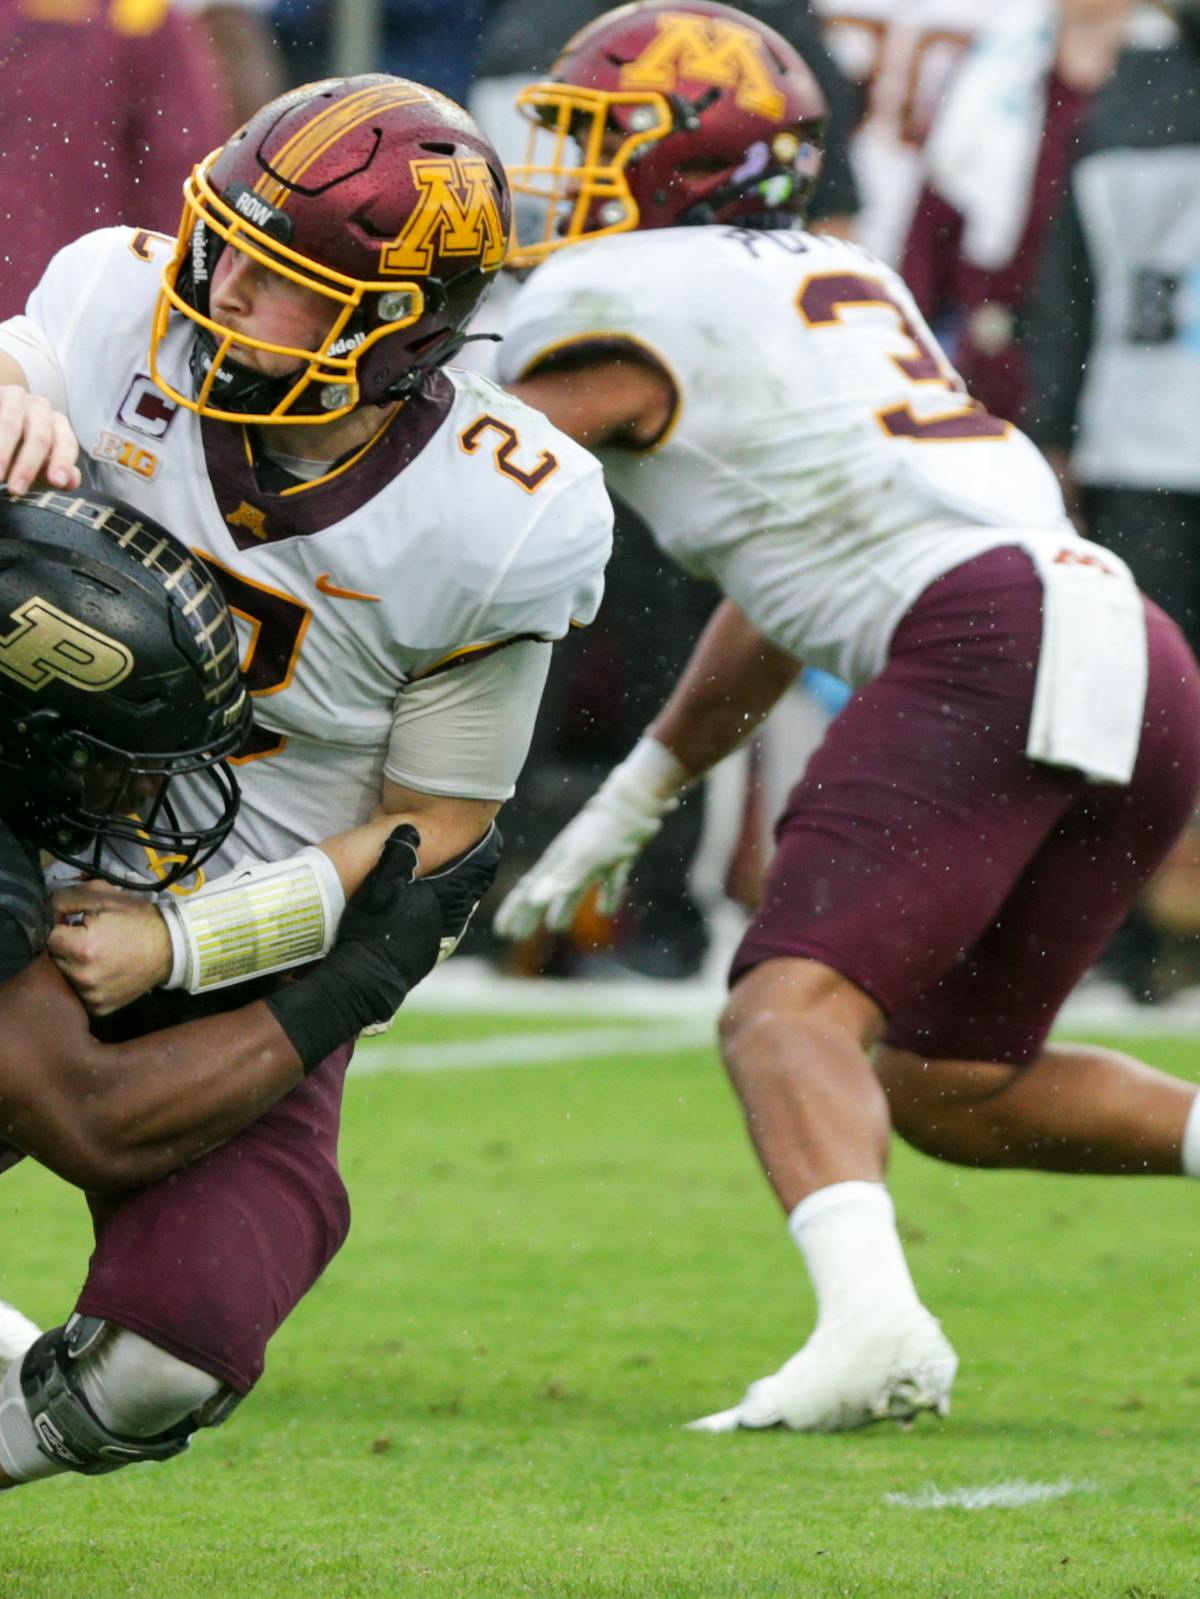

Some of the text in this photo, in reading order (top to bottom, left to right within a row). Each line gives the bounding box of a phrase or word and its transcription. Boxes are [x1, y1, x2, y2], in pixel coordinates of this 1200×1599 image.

[619, 11, 787, 123] M
[235, 191, 273, 227] ROW
[378, 158, 506, 275] M
[793, 268, 1013, 443] 3
[118, 374, 179, 438] C
[457, 411, 560, 496] 2
